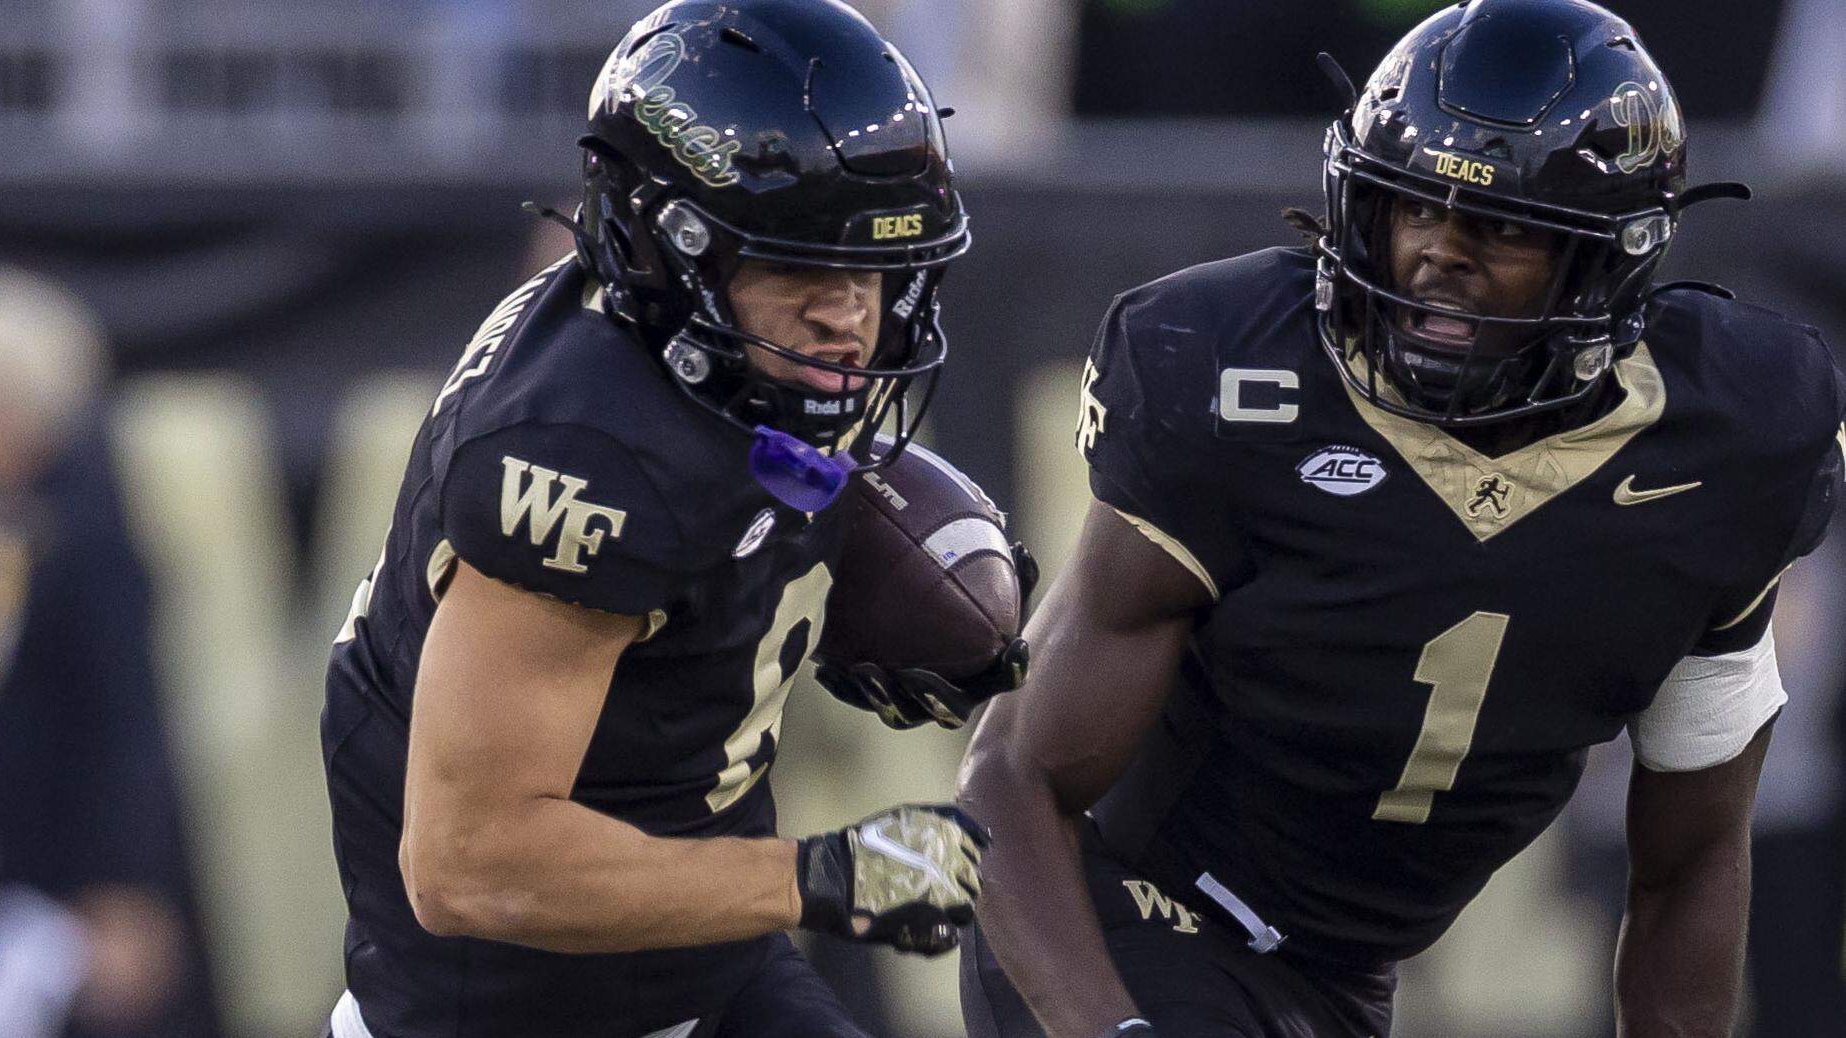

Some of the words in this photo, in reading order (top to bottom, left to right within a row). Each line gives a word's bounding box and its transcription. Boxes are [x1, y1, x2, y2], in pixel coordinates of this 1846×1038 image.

[1435, 151, 1495, 187] DEACS
[872, 213, 923, 240] DEACS
[1220, 368, 1300, 423] C
[1308, 458, 1381, 479] ACC
[501, 455, 627, 575] WF
[1371, 611, 1510, 824] 1
